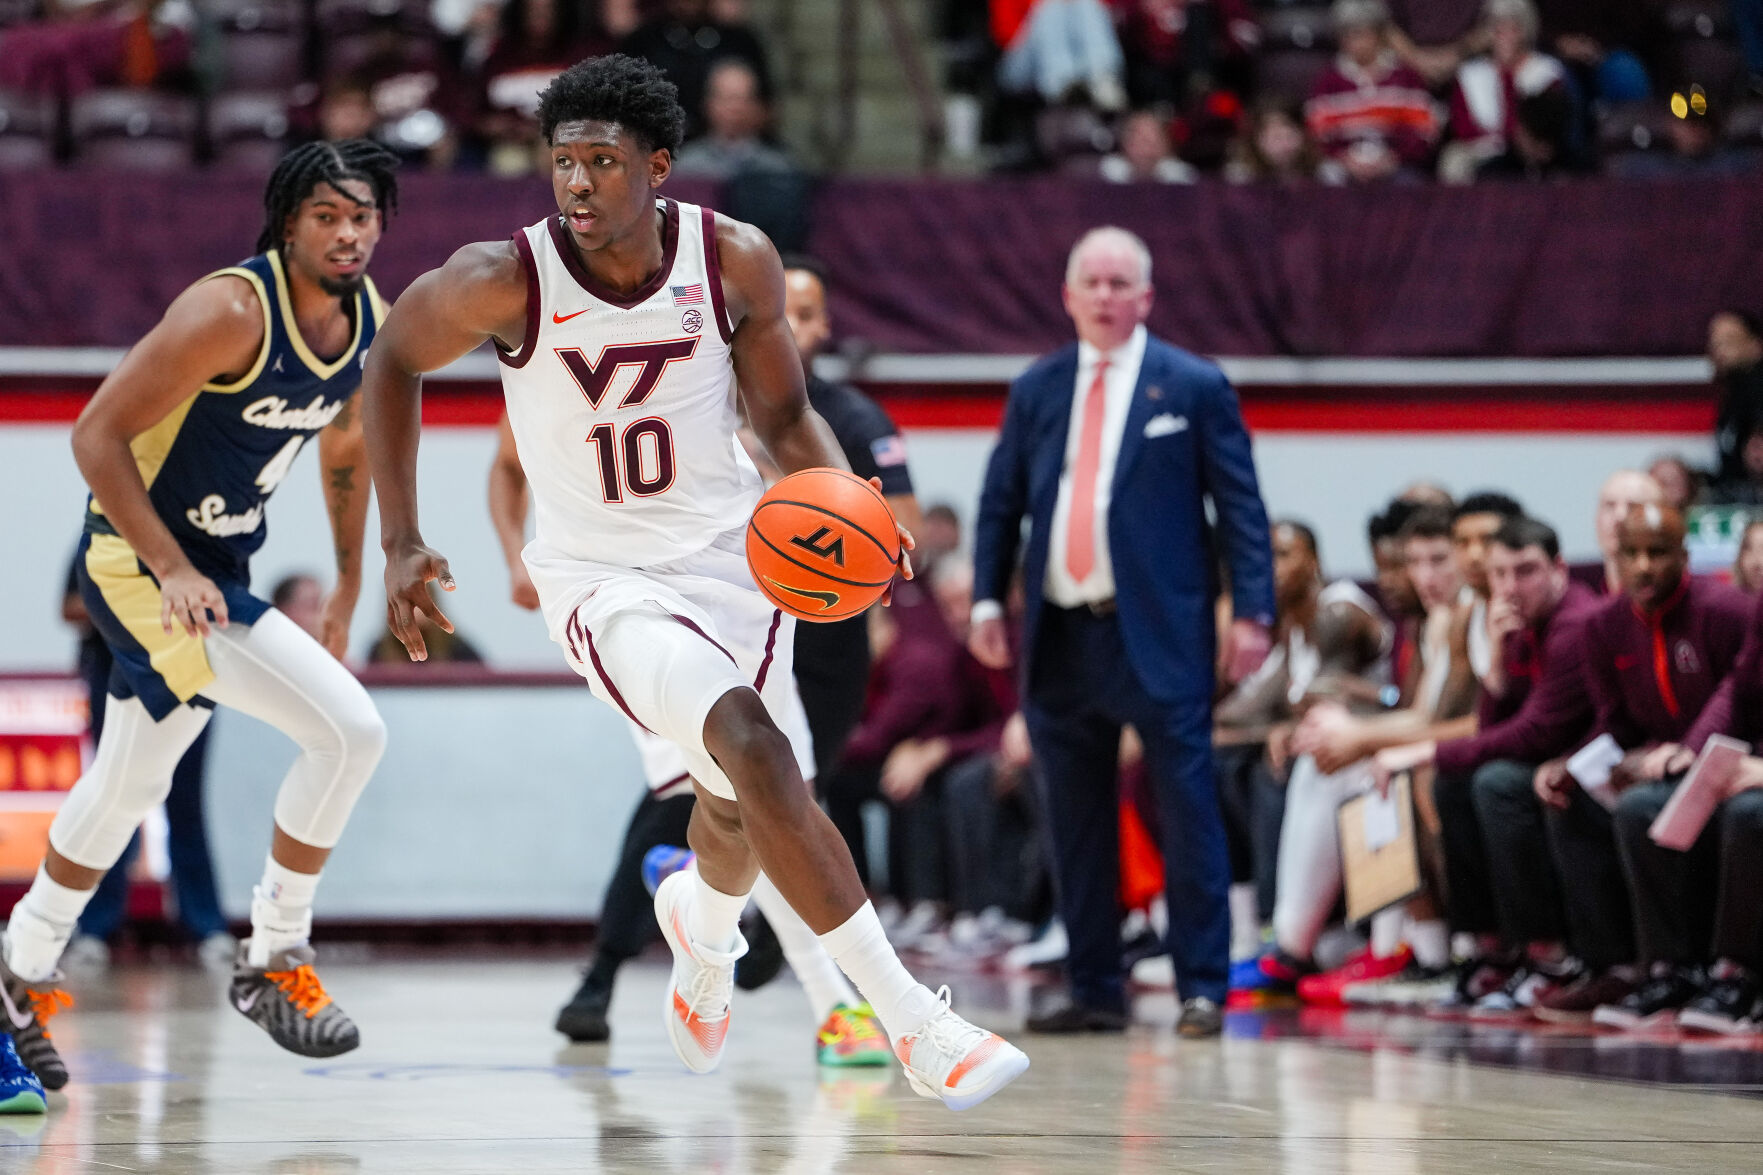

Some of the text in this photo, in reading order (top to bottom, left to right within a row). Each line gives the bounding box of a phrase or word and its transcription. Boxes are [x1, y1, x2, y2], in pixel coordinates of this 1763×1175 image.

[553, 335, 702, 411] VT
[254, 434, 305, 494] 4
[586, 416, 677, 503] 10
[788, 525, 845, 568] VT
